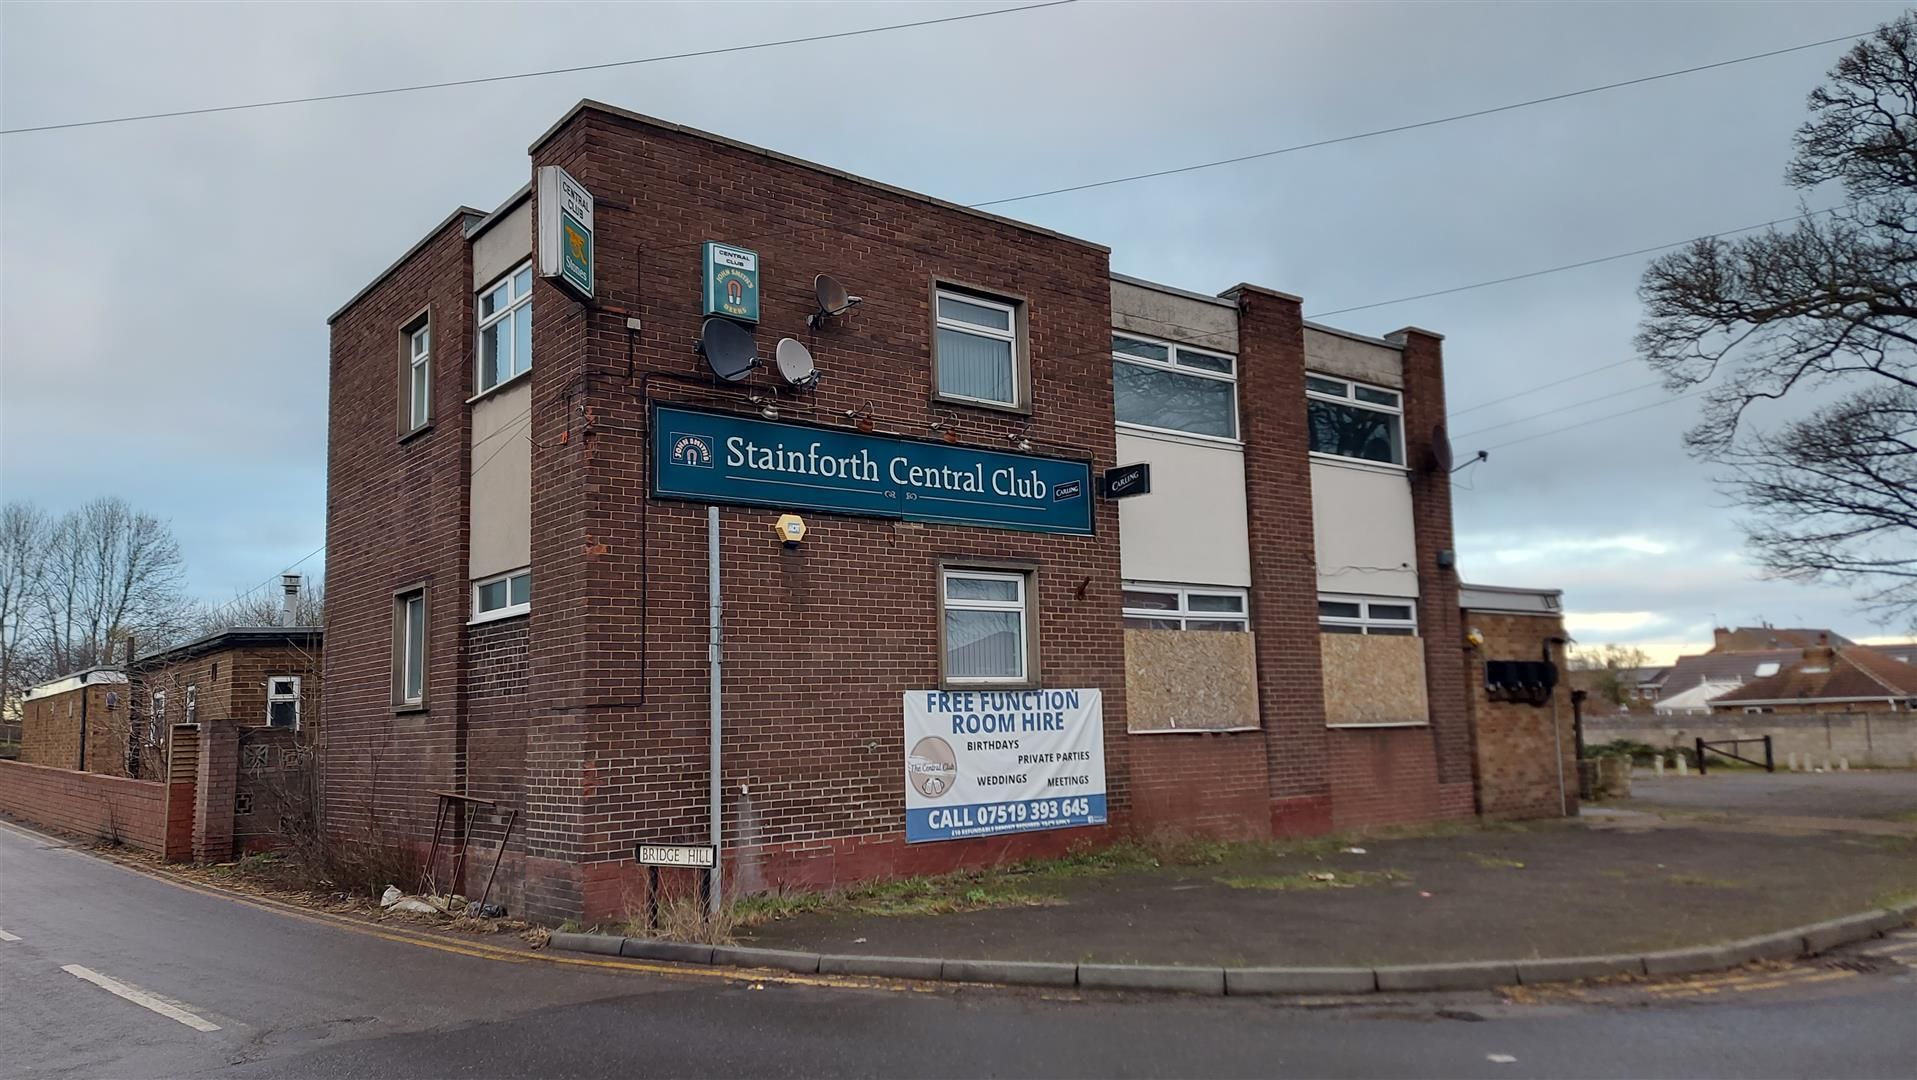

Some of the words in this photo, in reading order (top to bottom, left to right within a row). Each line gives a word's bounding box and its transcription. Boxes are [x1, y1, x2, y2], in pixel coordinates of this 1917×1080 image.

[562, 181, 590, 213] CENTRAL
[568, 199, 584, 219] CLUB
[719, 250, 750, 261] CENTRAL
[726, 259, 744, 267] CLUB
[716, 269, 731, 284] JOHN
[674, 438, 689, 458] JOHN
[726, 436, 880, 482] Stainforth
[889, 457, 985, 493] Central
[992, 467, 1047, 499] Club
[1112, 471, 1140, 491] CARLING
[1055, 485, 1079, 497] CARLING
[927, 692, 974, 713] FREE
[980, 691, 1079, 712] FUNCTION
[952, 713, 1015, 734] ROOM
[1022, 712, 1064, 732] HIRE
[967, 740, 1020, 752] BIRTHDAYS
[1018, 753, 1054, 764] PRIVATE
[1056, 751, 1090, 762] PARTIES
[977, 774, 1028, 786] WEDDINGS
[1047, 775, 1089, 787] MEETINGS
[928, 807, 973, 829] CALL
[977, 803, 1027, 825] 07519
[1030, 800, 1059, 821] 393
[1062, 798, 1089, 817] 645
[642, 847, 680, 862] BRIDGE
[688, 849, 711, 863] HILL
